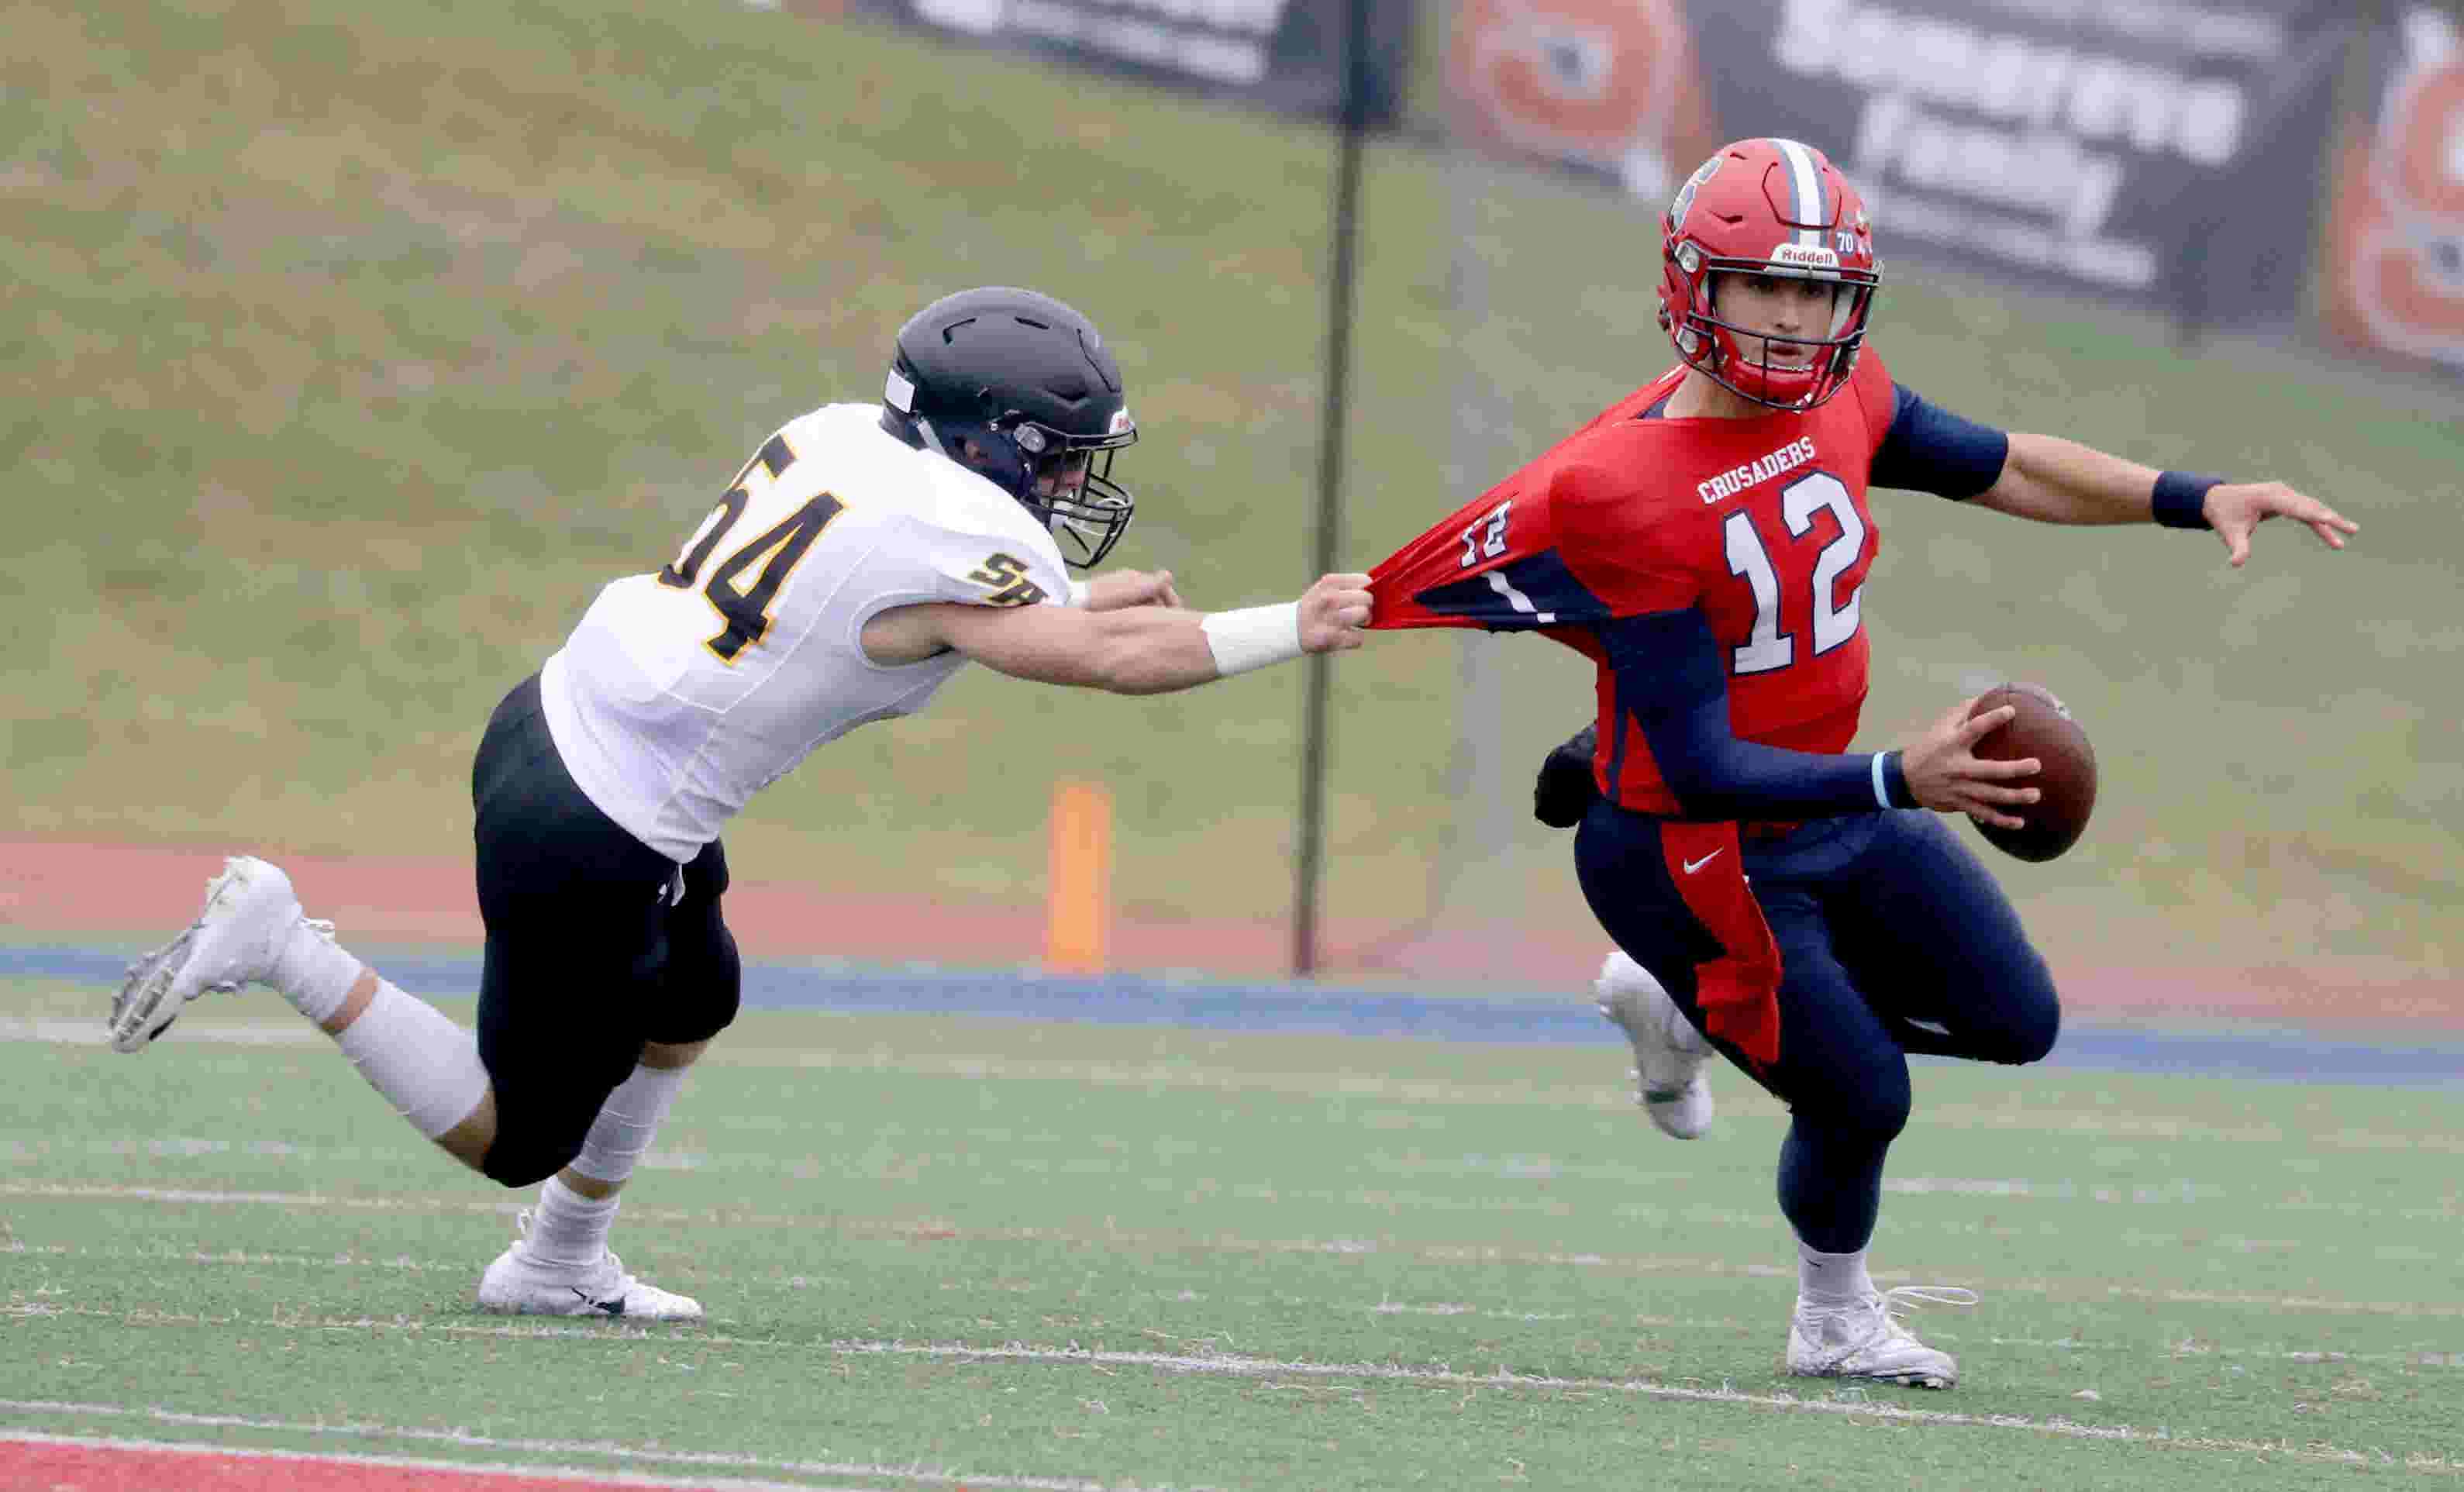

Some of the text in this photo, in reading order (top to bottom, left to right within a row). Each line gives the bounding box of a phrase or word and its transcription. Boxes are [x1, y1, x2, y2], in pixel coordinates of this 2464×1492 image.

[1782, 249, 1833, 264] Riddell
[1836, 232, 1854, 253] 70
[1697, 436, 1816, 504] CRUSADERS
[657, 434, 846, 665] 54
[1722, 469, 1866, 676] 12
